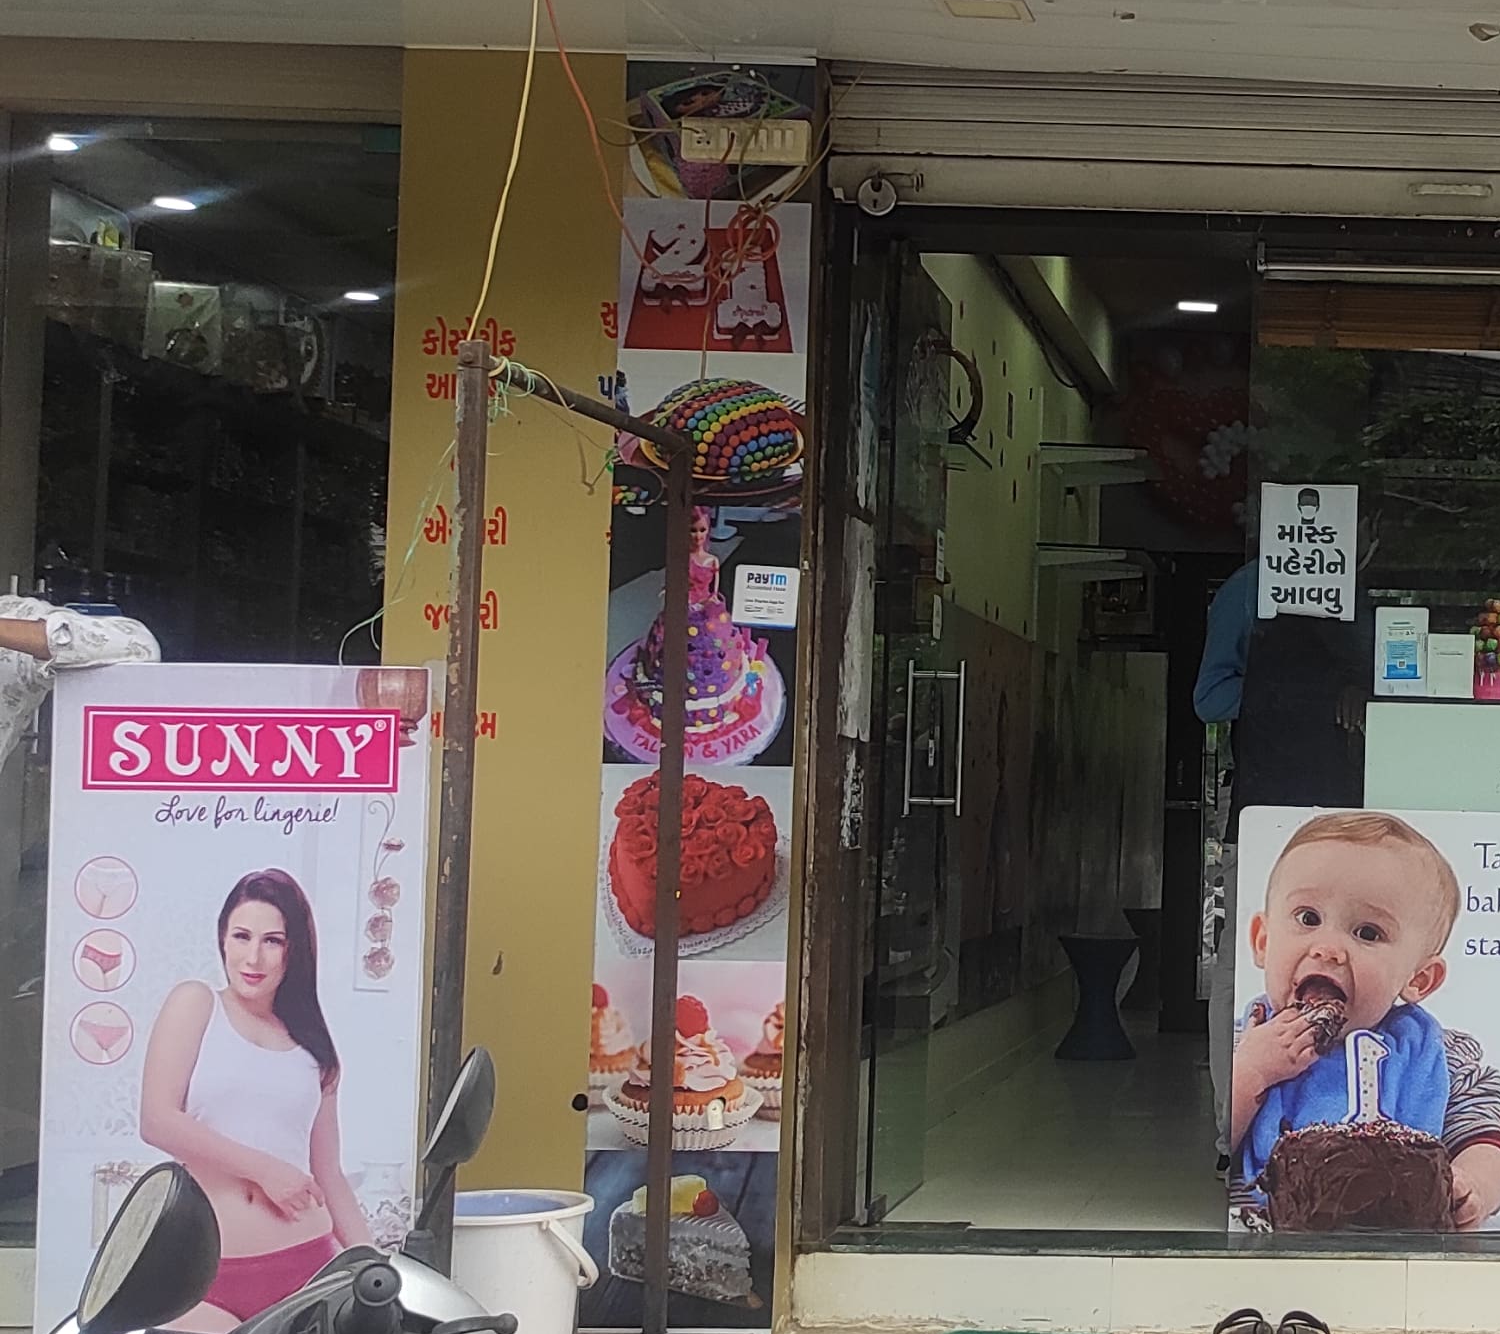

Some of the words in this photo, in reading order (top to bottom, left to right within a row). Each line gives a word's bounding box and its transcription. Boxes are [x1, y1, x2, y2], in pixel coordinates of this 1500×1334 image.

[1277, 524, 1338, 544] માસ્ક
[1265, 547, 1346, 575] પહેરીને
[1270, 586, 1344, 615] આવવુ
[108, 719, 375, 780] SUNNY
[155, 795, 208, 823] Love
[214, 796, 248, 827] for
[254, 797, 340, 834] lingerie!
